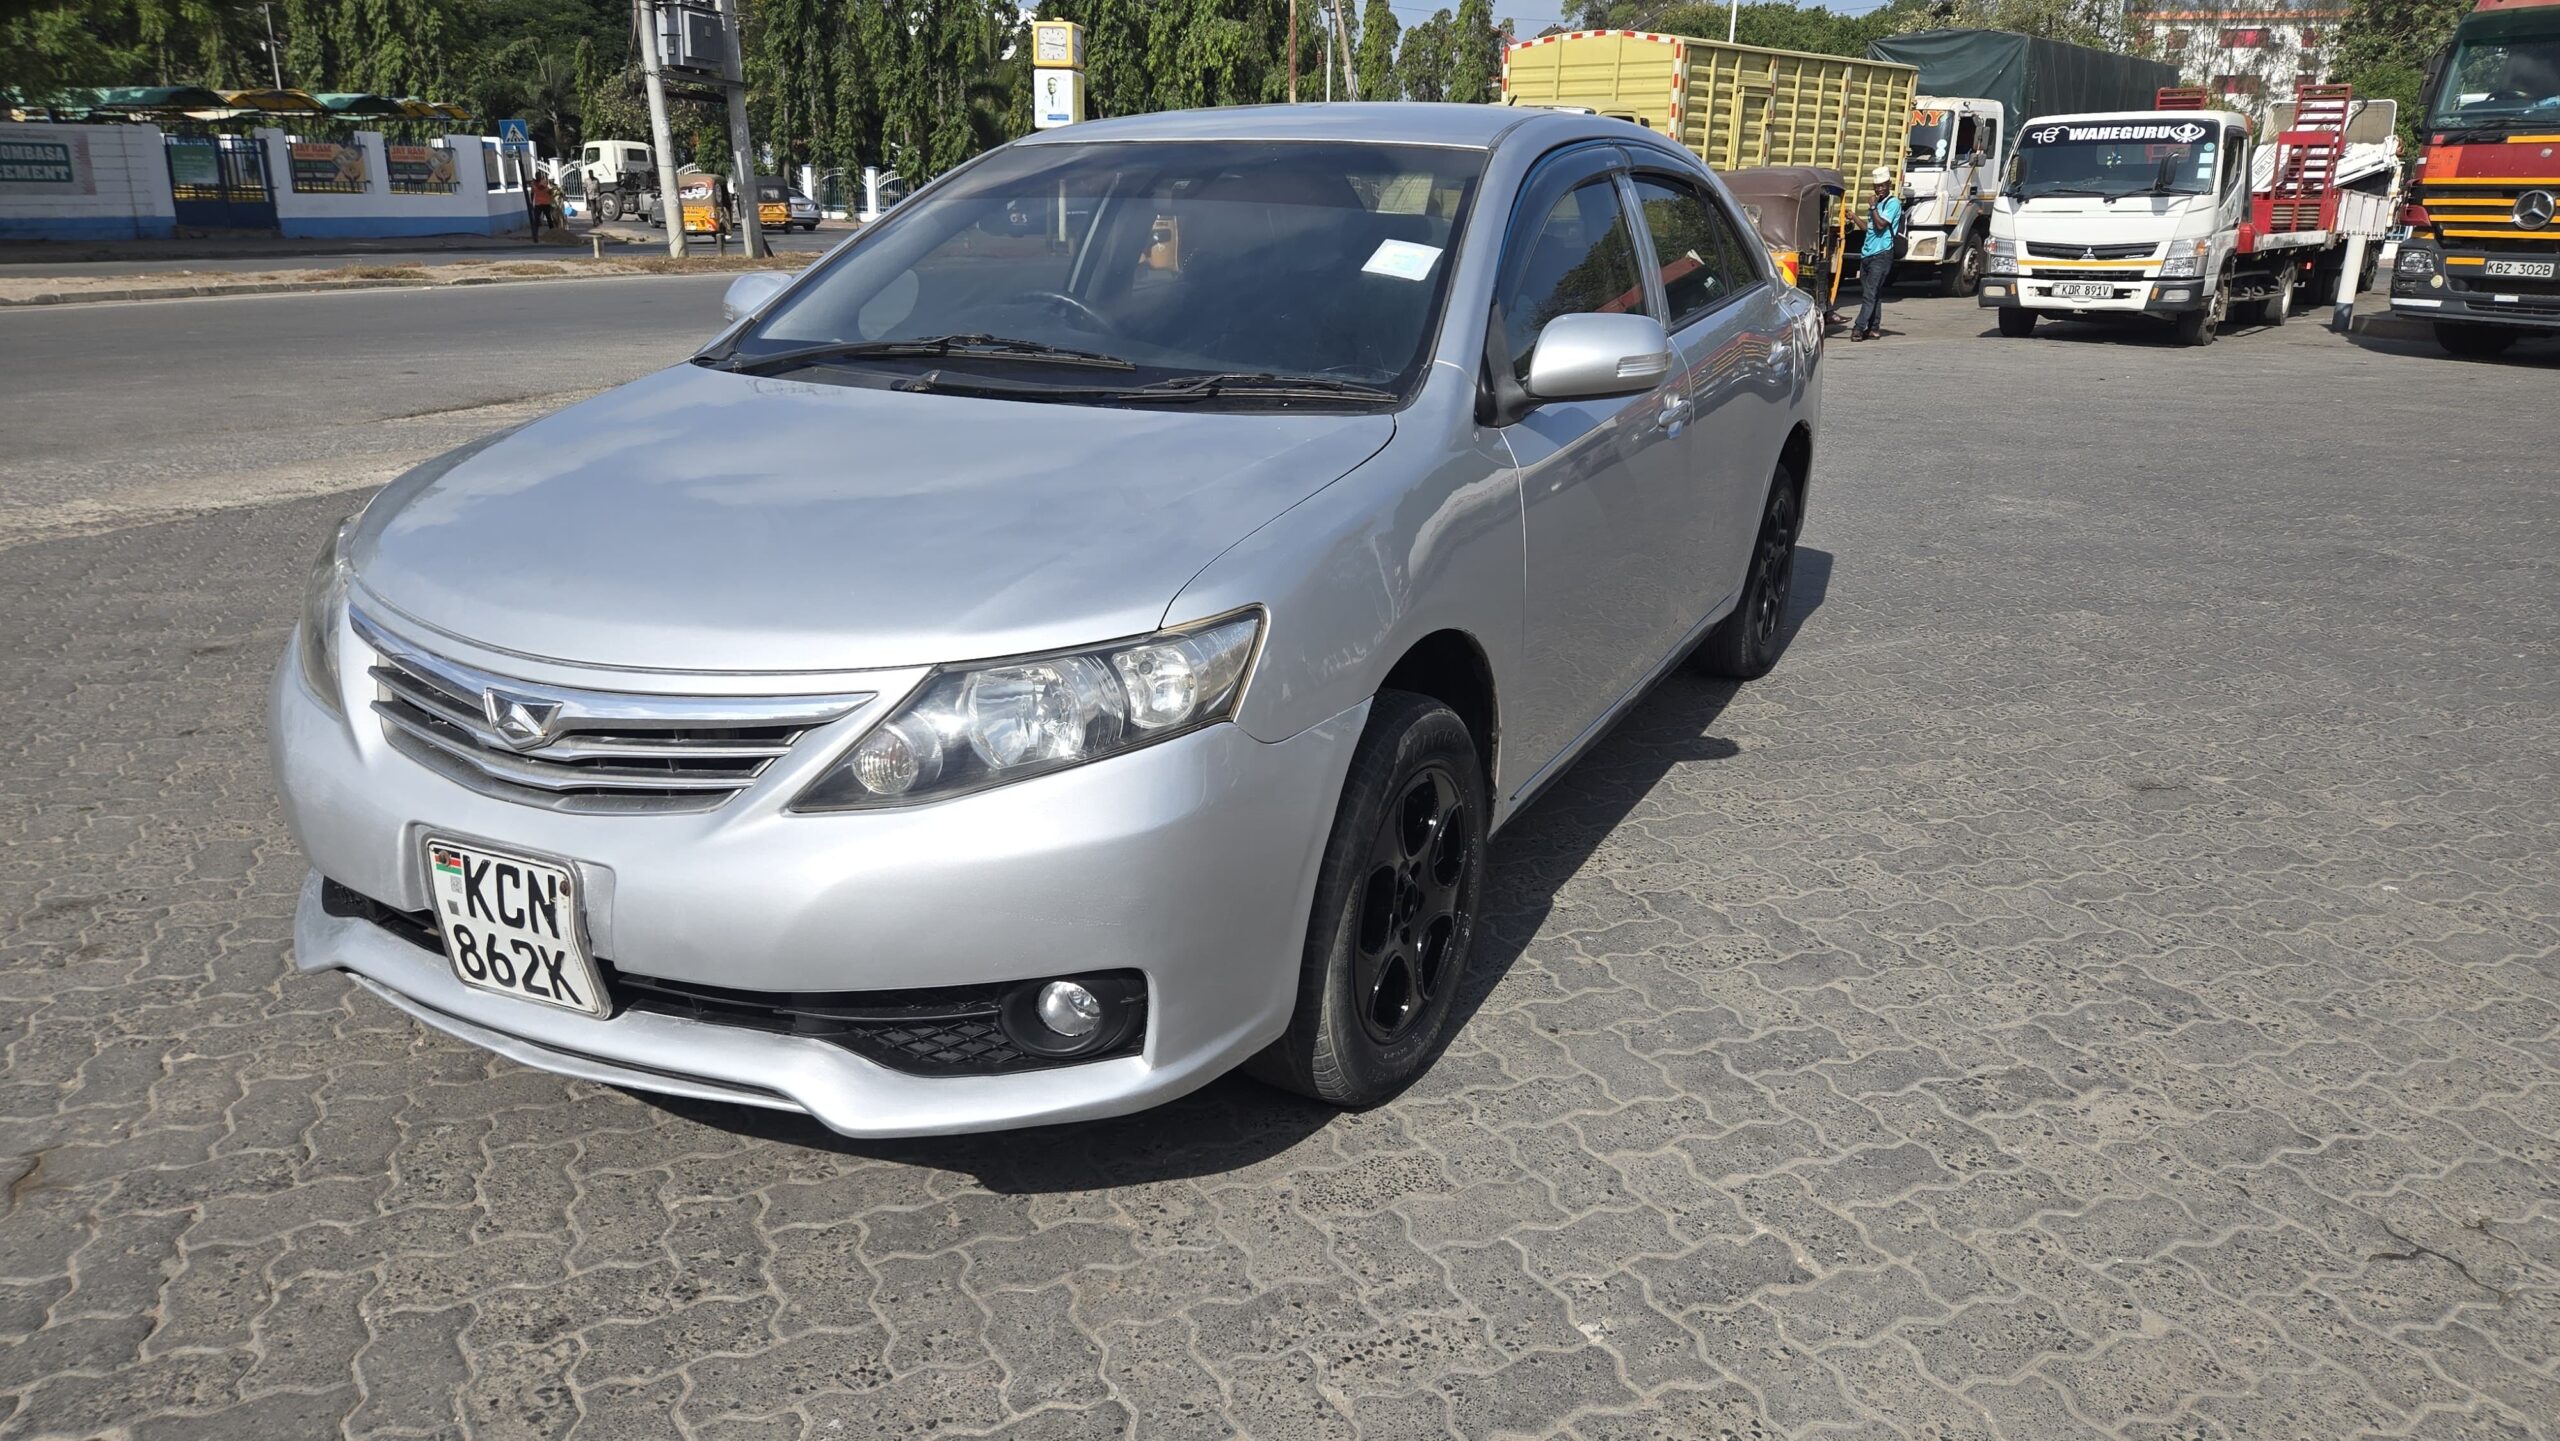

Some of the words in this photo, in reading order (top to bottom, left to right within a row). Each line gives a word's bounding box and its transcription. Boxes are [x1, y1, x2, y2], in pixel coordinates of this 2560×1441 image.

[2068, 126, 2172, 141] WAHEGURU
[0, 144, 66, 161] OMBASA
[2487, 262, 2513, 275] KBZ
[2518, 263, 2551, 276] 302B
[2061, 284, 2081, 296] KDR
[2085, 284, 2110, 296] 891V
[462, 854, 560, 940] KCN
[453, 923, 583, 1005] 862K
